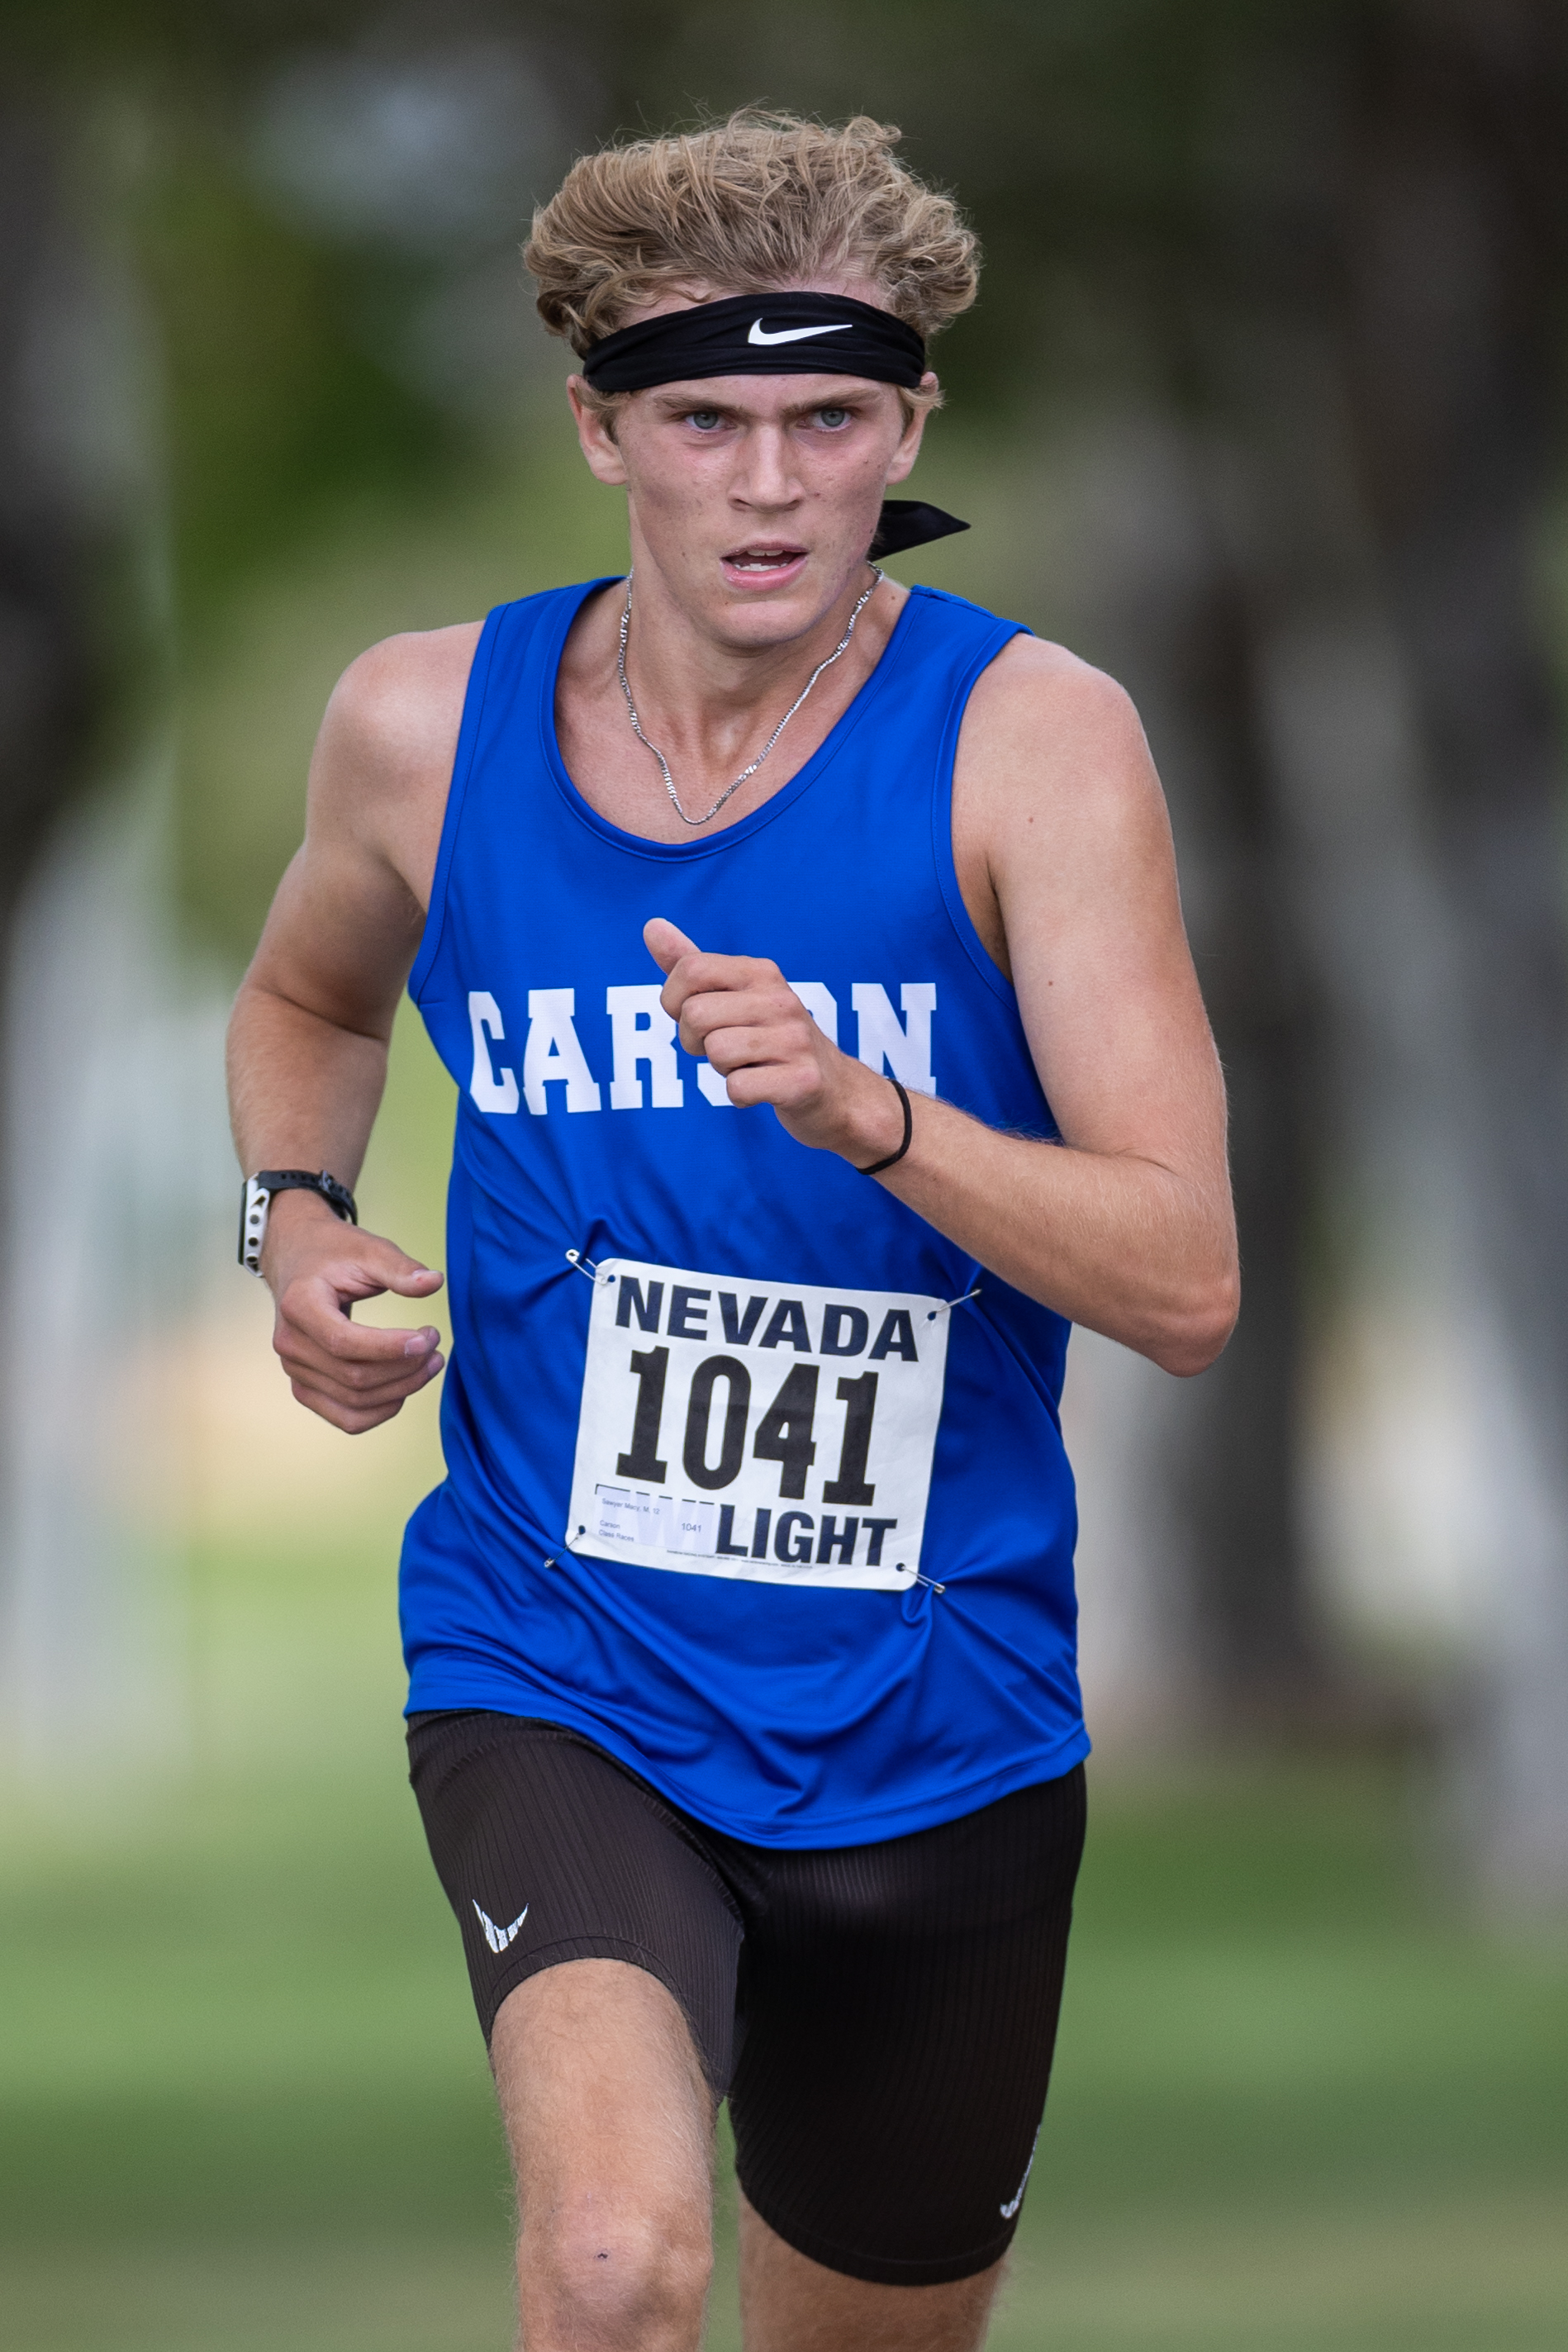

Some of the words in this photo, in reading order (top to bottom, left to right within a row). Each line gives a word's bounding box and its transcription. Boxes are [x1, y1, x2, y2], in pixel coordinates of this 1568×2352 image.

[468, 981, 937, 1115] CARN
[615, 1275, 919, 1362] NEVADA
[615, 1345, 880, 1507] 1041
[601, 1498, 623, 1509] Sawyer
[600, 1519, 620, 1529] Carson
[681, 1523, 702, 1533] 1041
[598, 1529, 615, 1538] Class
[615, 1532, 634, 1542] Races
